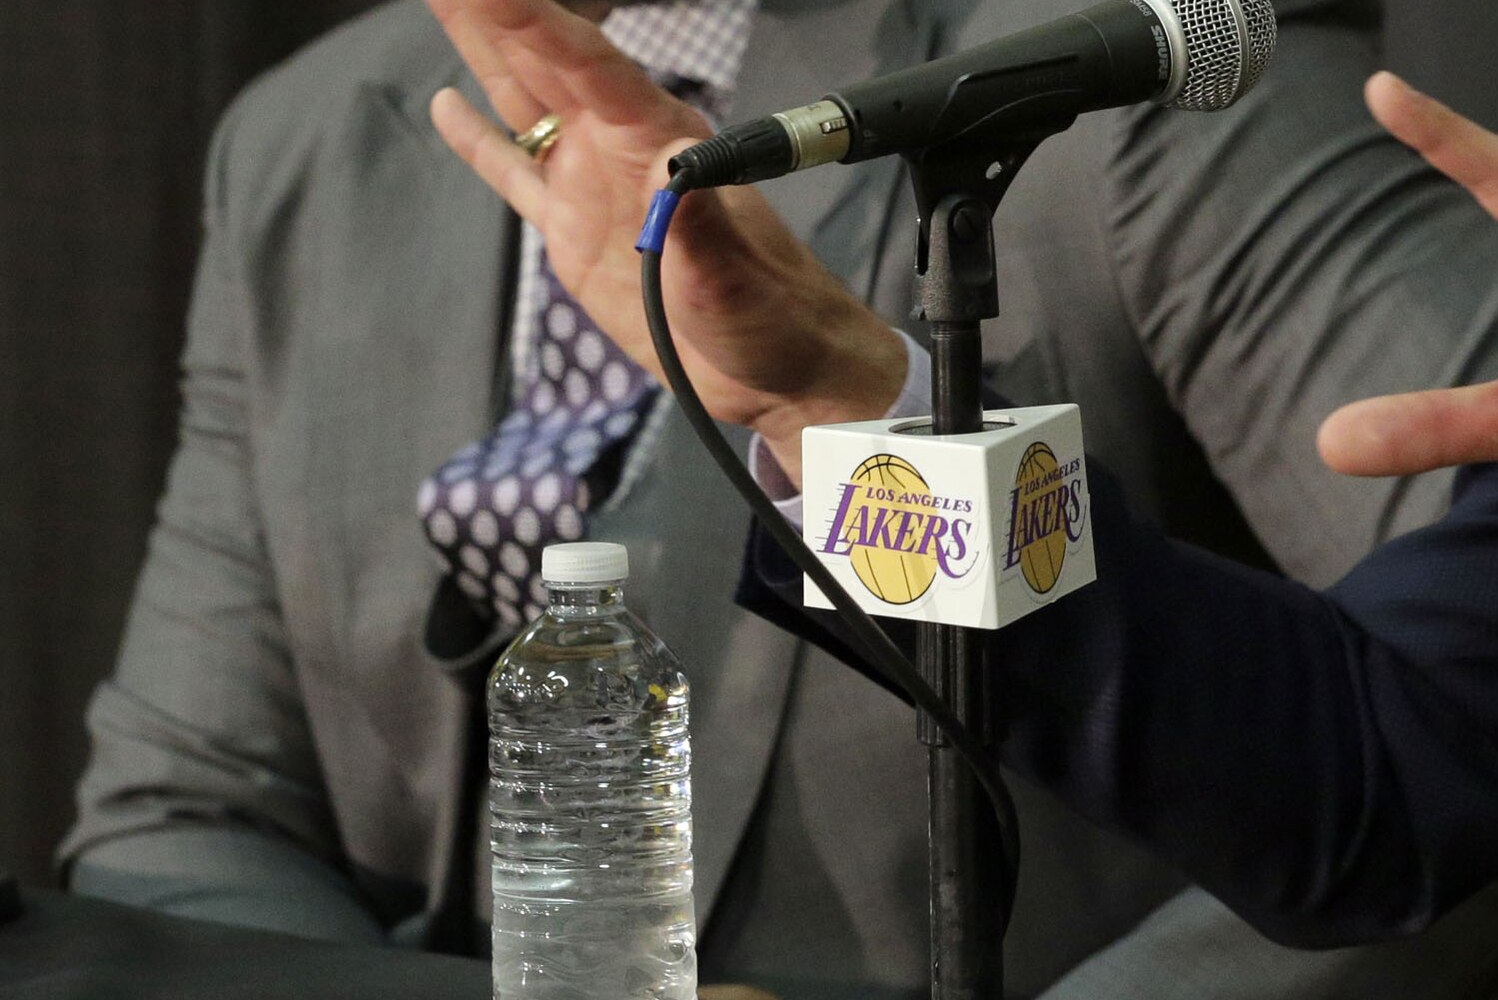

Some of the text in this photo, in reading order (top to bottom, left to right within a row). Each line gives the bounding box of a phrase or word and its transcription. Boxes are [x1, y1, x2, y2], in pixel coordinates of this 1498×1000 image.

[1151, 25, 1168, 80] SHURE
[866, 487, 974, 513] LOS ANGELES
[1024, 458, 1080, 495] LOS ANGELES
[816, 483, 979, 579] LAKERS
[1003, 479, 1087, 572] LAKERS
